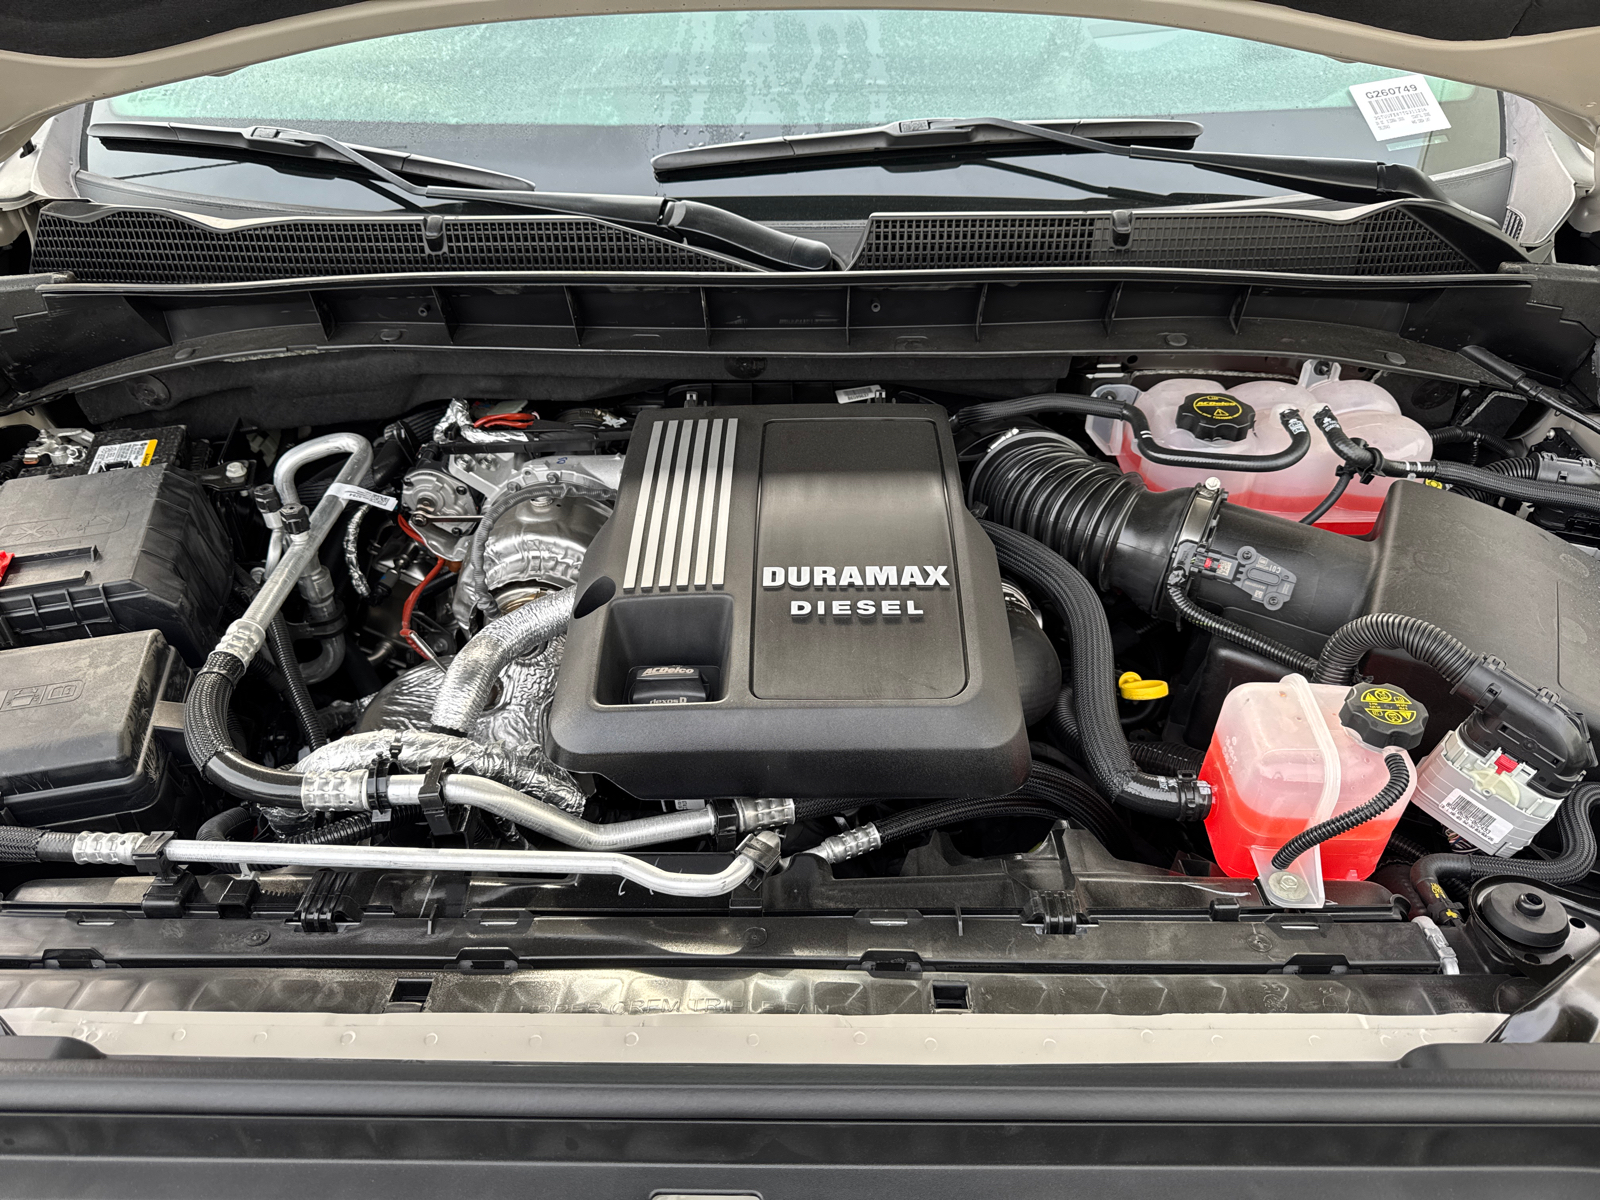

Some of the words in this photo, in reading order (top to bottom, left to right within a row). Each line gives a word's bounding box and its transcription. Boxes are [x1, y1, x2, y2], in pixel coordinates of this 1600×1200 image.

[762, 566, 950, 588] DURAMAX
[790, 600, 924, 616] DIESEL
[641, 666, 695, 677] ACDelco
